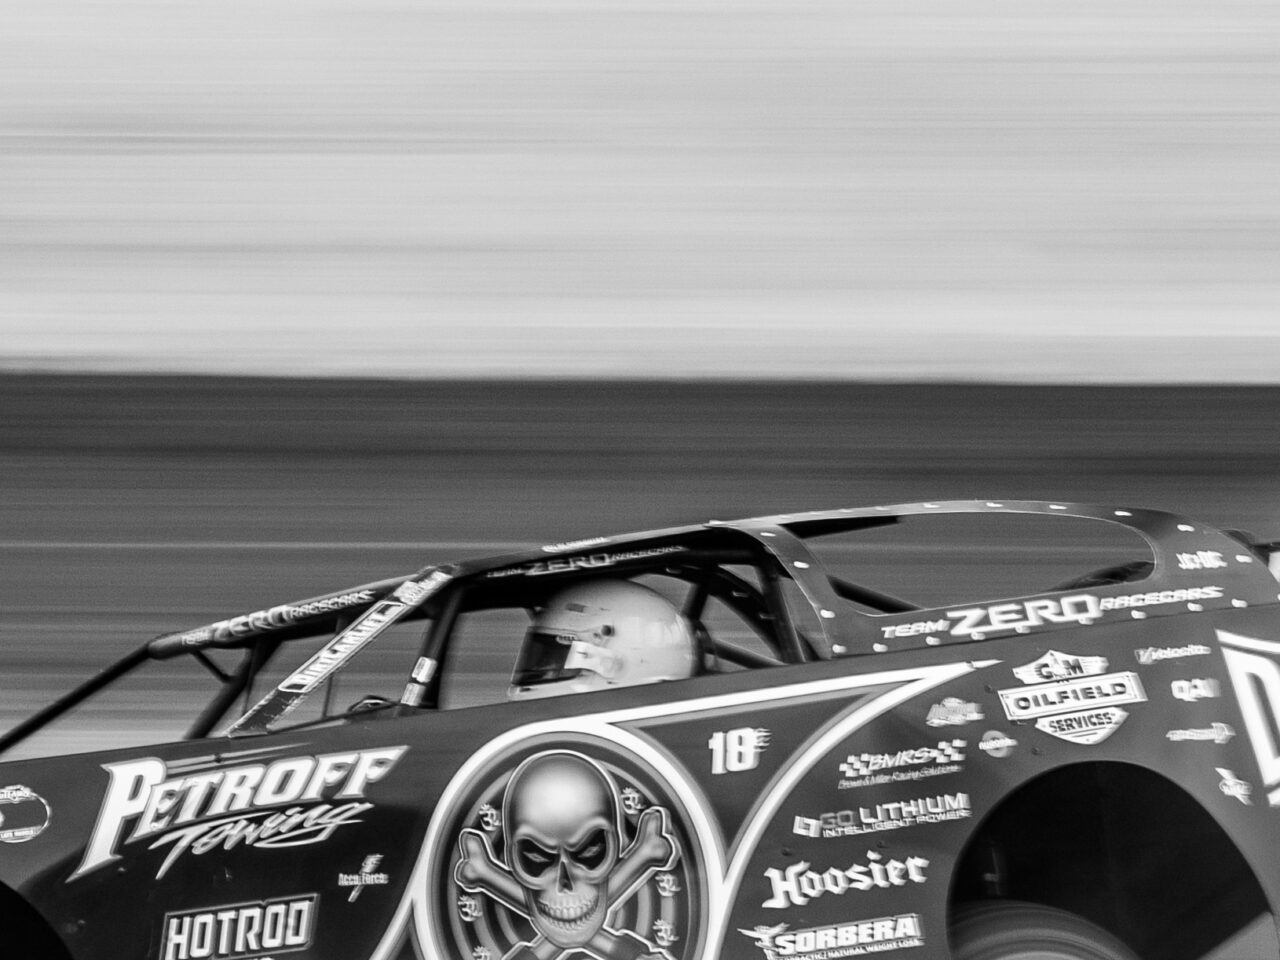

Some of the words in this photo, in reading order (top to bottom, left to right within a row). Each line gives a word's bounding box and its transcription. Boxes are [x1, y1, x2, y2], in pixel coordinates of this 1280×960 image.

[524, 553, 616, 577] ZERO
[289, 591, 376, 619] RACECARS
[881, 619, 951, 638] TEAM
[945, 594, 1103, 635] ZERO
[1100, 586, 1224, 610] RACECARS
[1014, 682, 1127, 710] OILFIELD
[1048, 712, 1113, 733] SERVICES
[708, 728, 762, 774] 18
[869, 747, 946, 771] BMRS
[65, 745, 411, 883] PETROFF
[820, 811, 859, 829] GO
[859, 792, 970, 824] LITHIUM
[823, 818, 916, 838] INTELLIGENT
[149, 803, 375, 880] Towing
[762, 850, 929, 908] Hoosier
[165, 901, 313, 960] HOTROD
[774, 914, 924, 956] SORBERA
[828, 944, 866, 959] NATURAL
[866, 941, 898, 953] WEIGHT
[898, 938, 925, 949] LOSS
